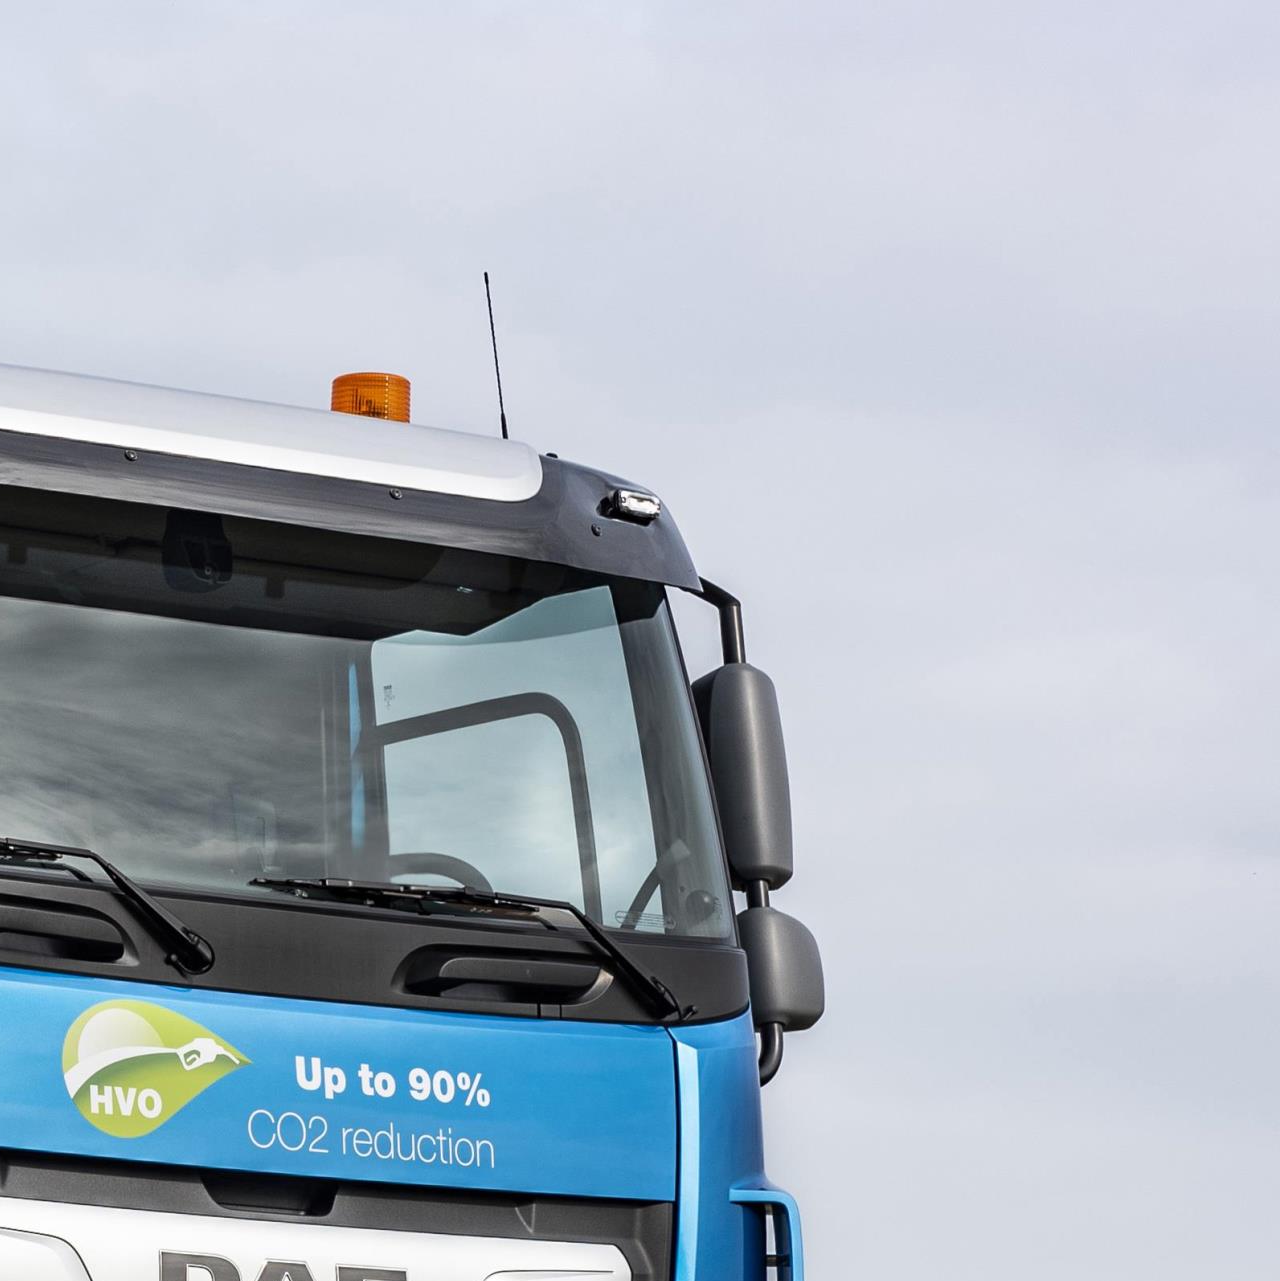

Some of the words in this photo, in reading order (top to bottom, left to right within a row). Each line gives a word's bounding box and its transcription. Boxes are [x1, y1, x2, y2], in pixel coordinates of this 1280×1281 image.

[89, 1083, 163, 1119] HVO
[294, 1055, 347, 1100] Up
[358, 1062, 396, 1098] to
[408, 1067, 491, 1108] 90%
[247, 1109, 329, 1154] CO2
[341, 1118, 495, 1169] reduction
